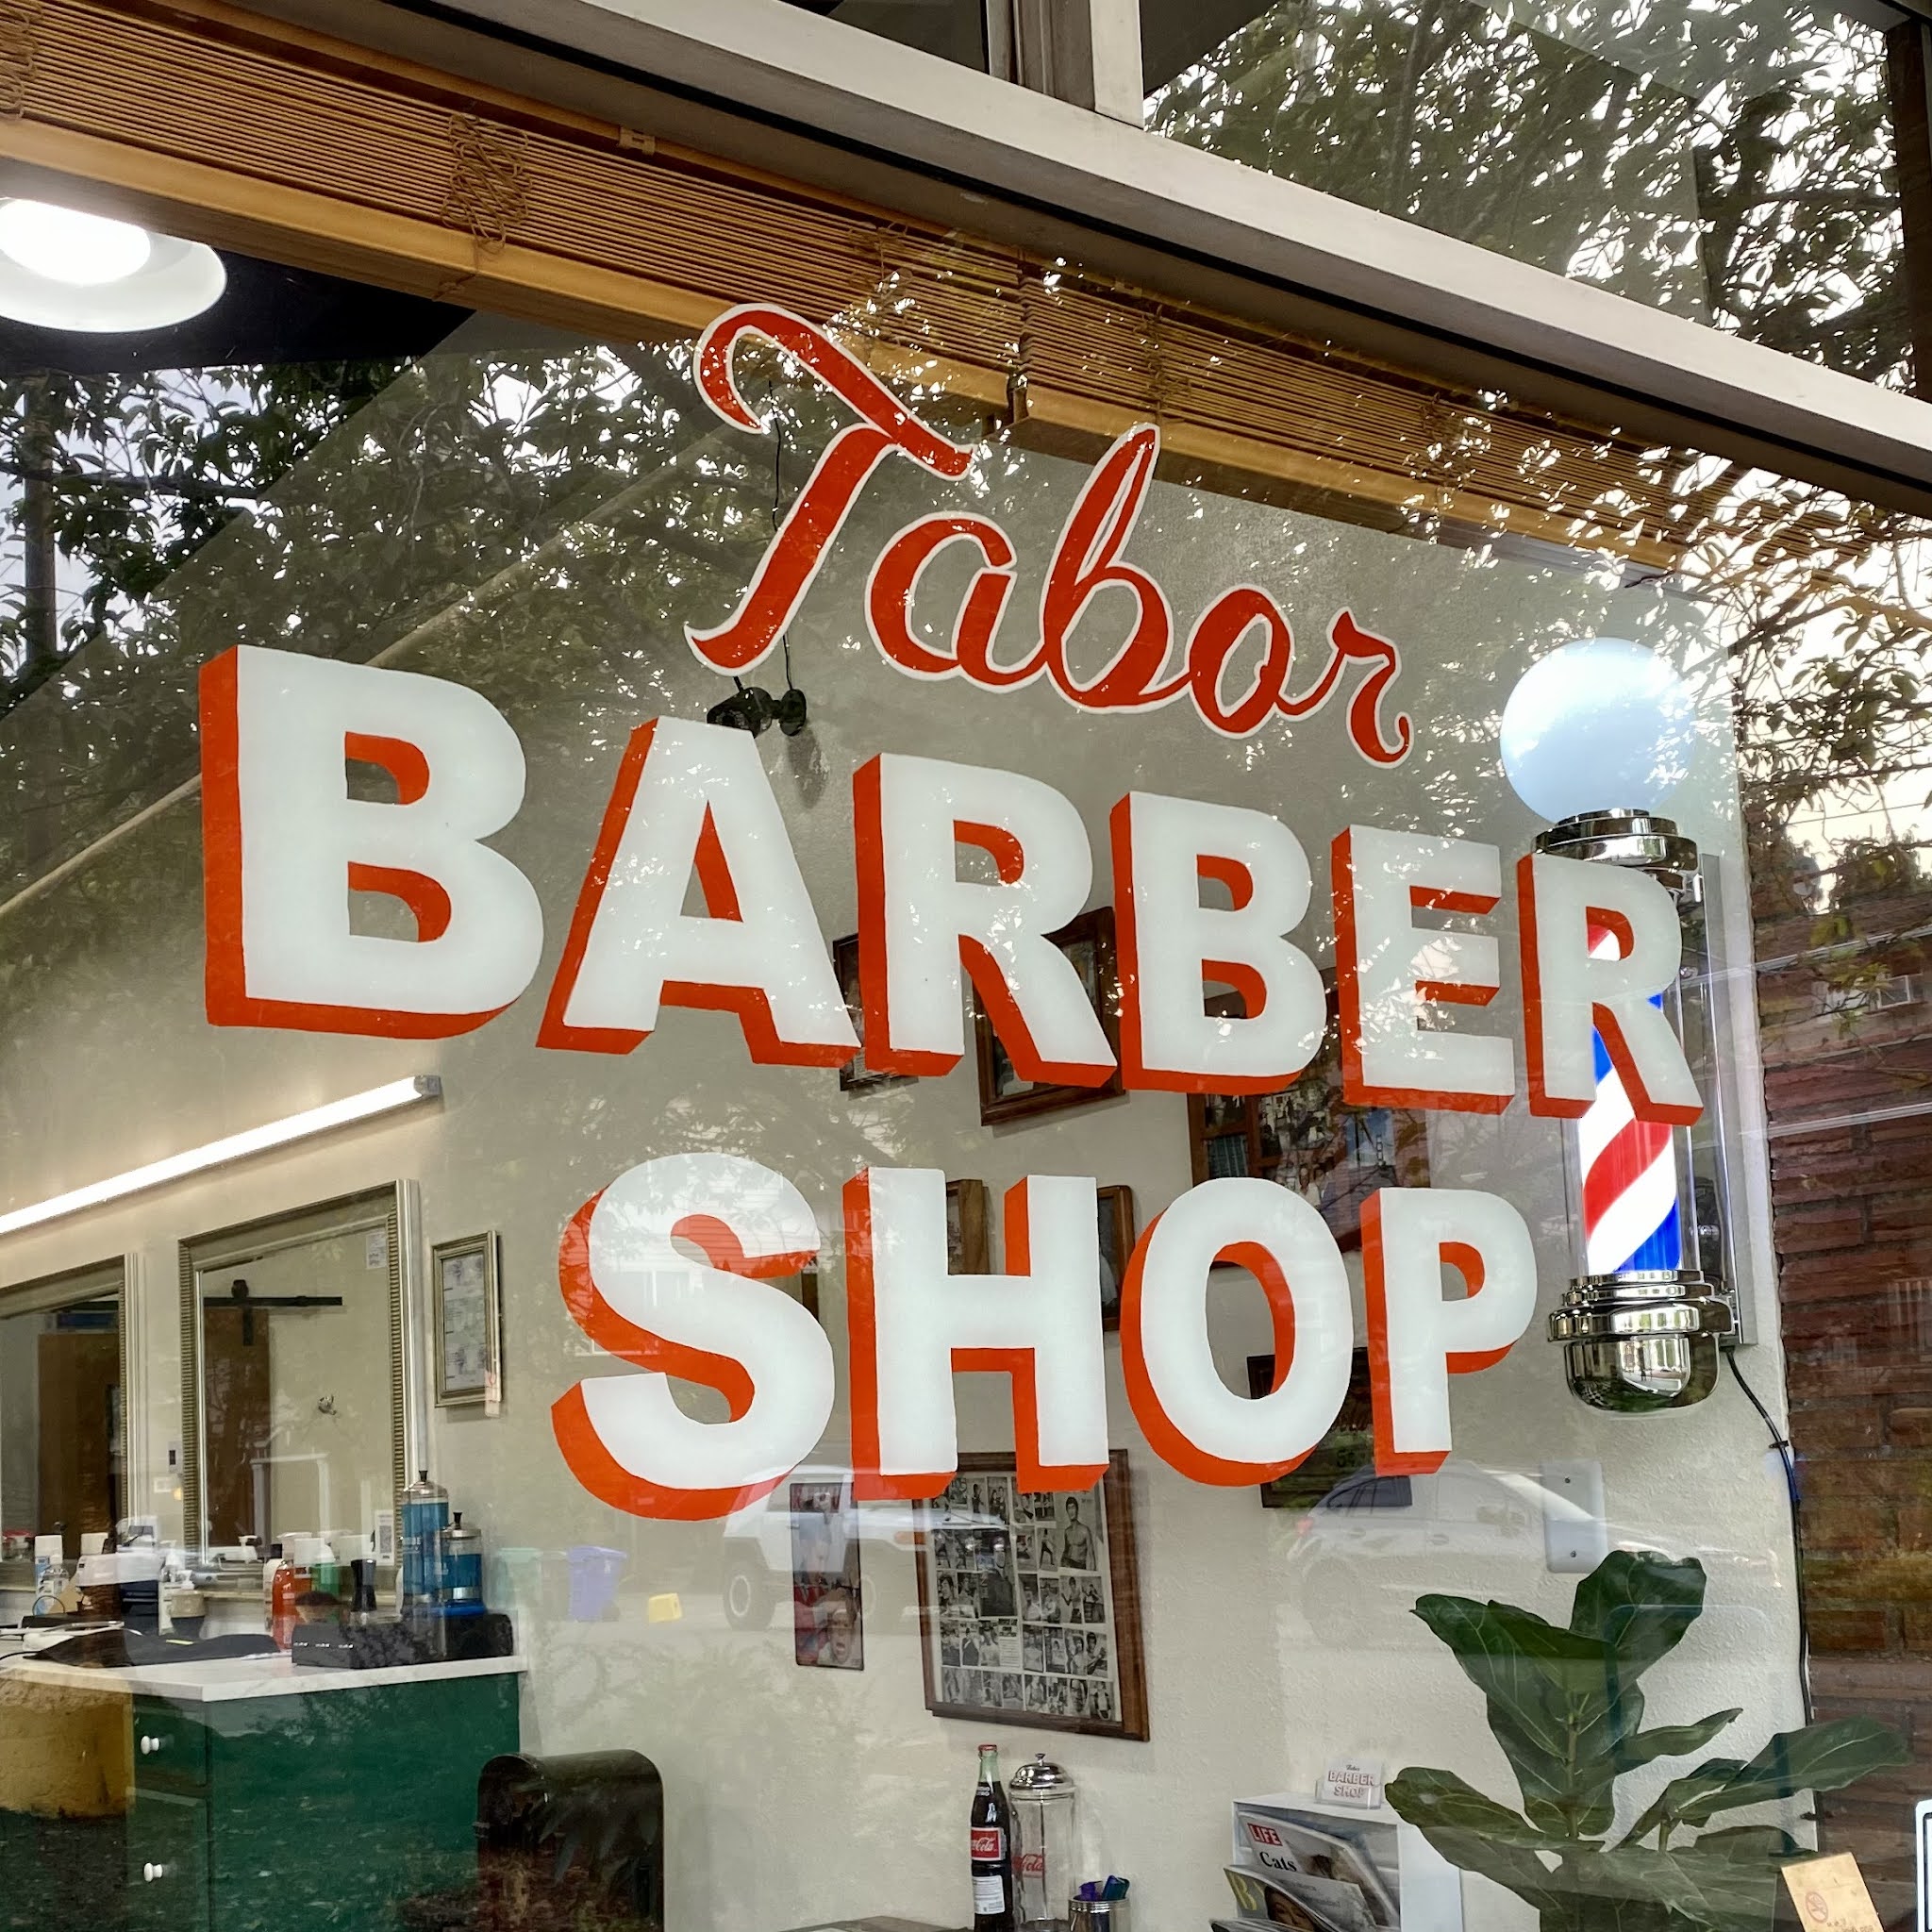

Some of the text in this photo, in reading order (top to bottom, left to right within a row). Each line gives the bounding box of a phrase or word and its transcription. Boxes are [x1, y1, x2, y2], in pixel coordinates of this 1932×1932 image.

[684, 302, 1414, 769] Tabor
[199, 644, 1704, 1127] BARBER
[551, 1152, 1538, 1522] SHOP
[1248, 1824, 1283, 1846] LIFE
[1259, 1851, 1297, 1872] Cats
[1327, 1771, 1374, 1787] BARBER
